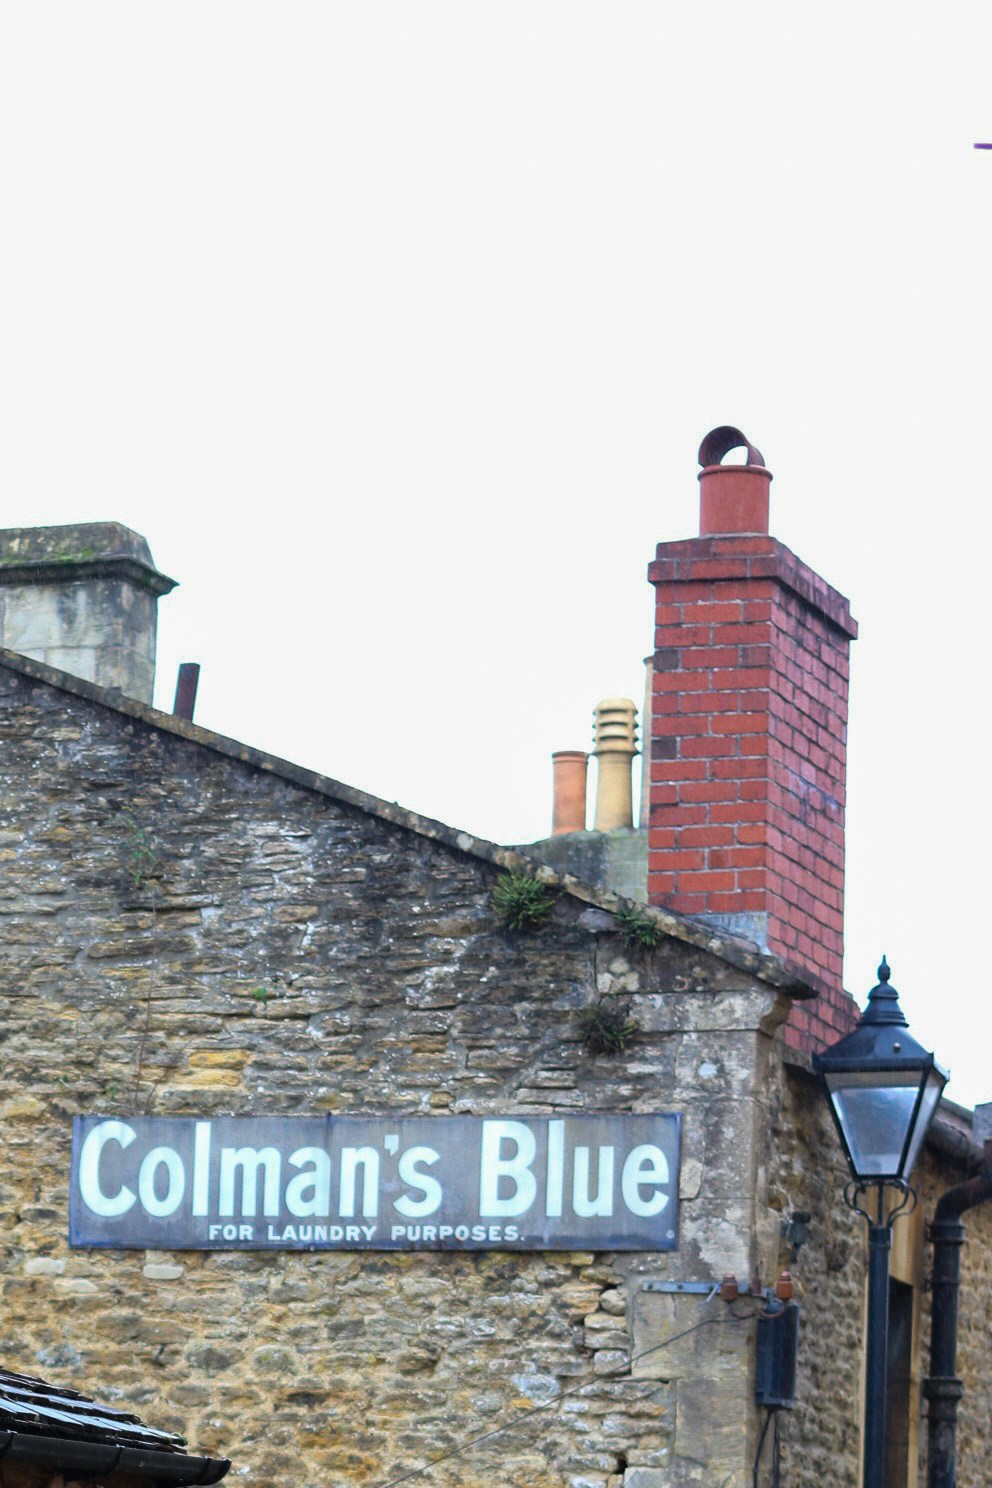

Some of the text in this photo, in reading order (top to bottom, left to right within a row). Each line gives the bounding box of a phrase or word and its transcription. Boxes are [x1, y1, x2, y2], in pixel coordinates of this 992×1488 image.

[79, 1119, 670, 1218] Colman's Blue
[209, 1225, 526, 1242] FOR LAUNDRY PURPOSES.
